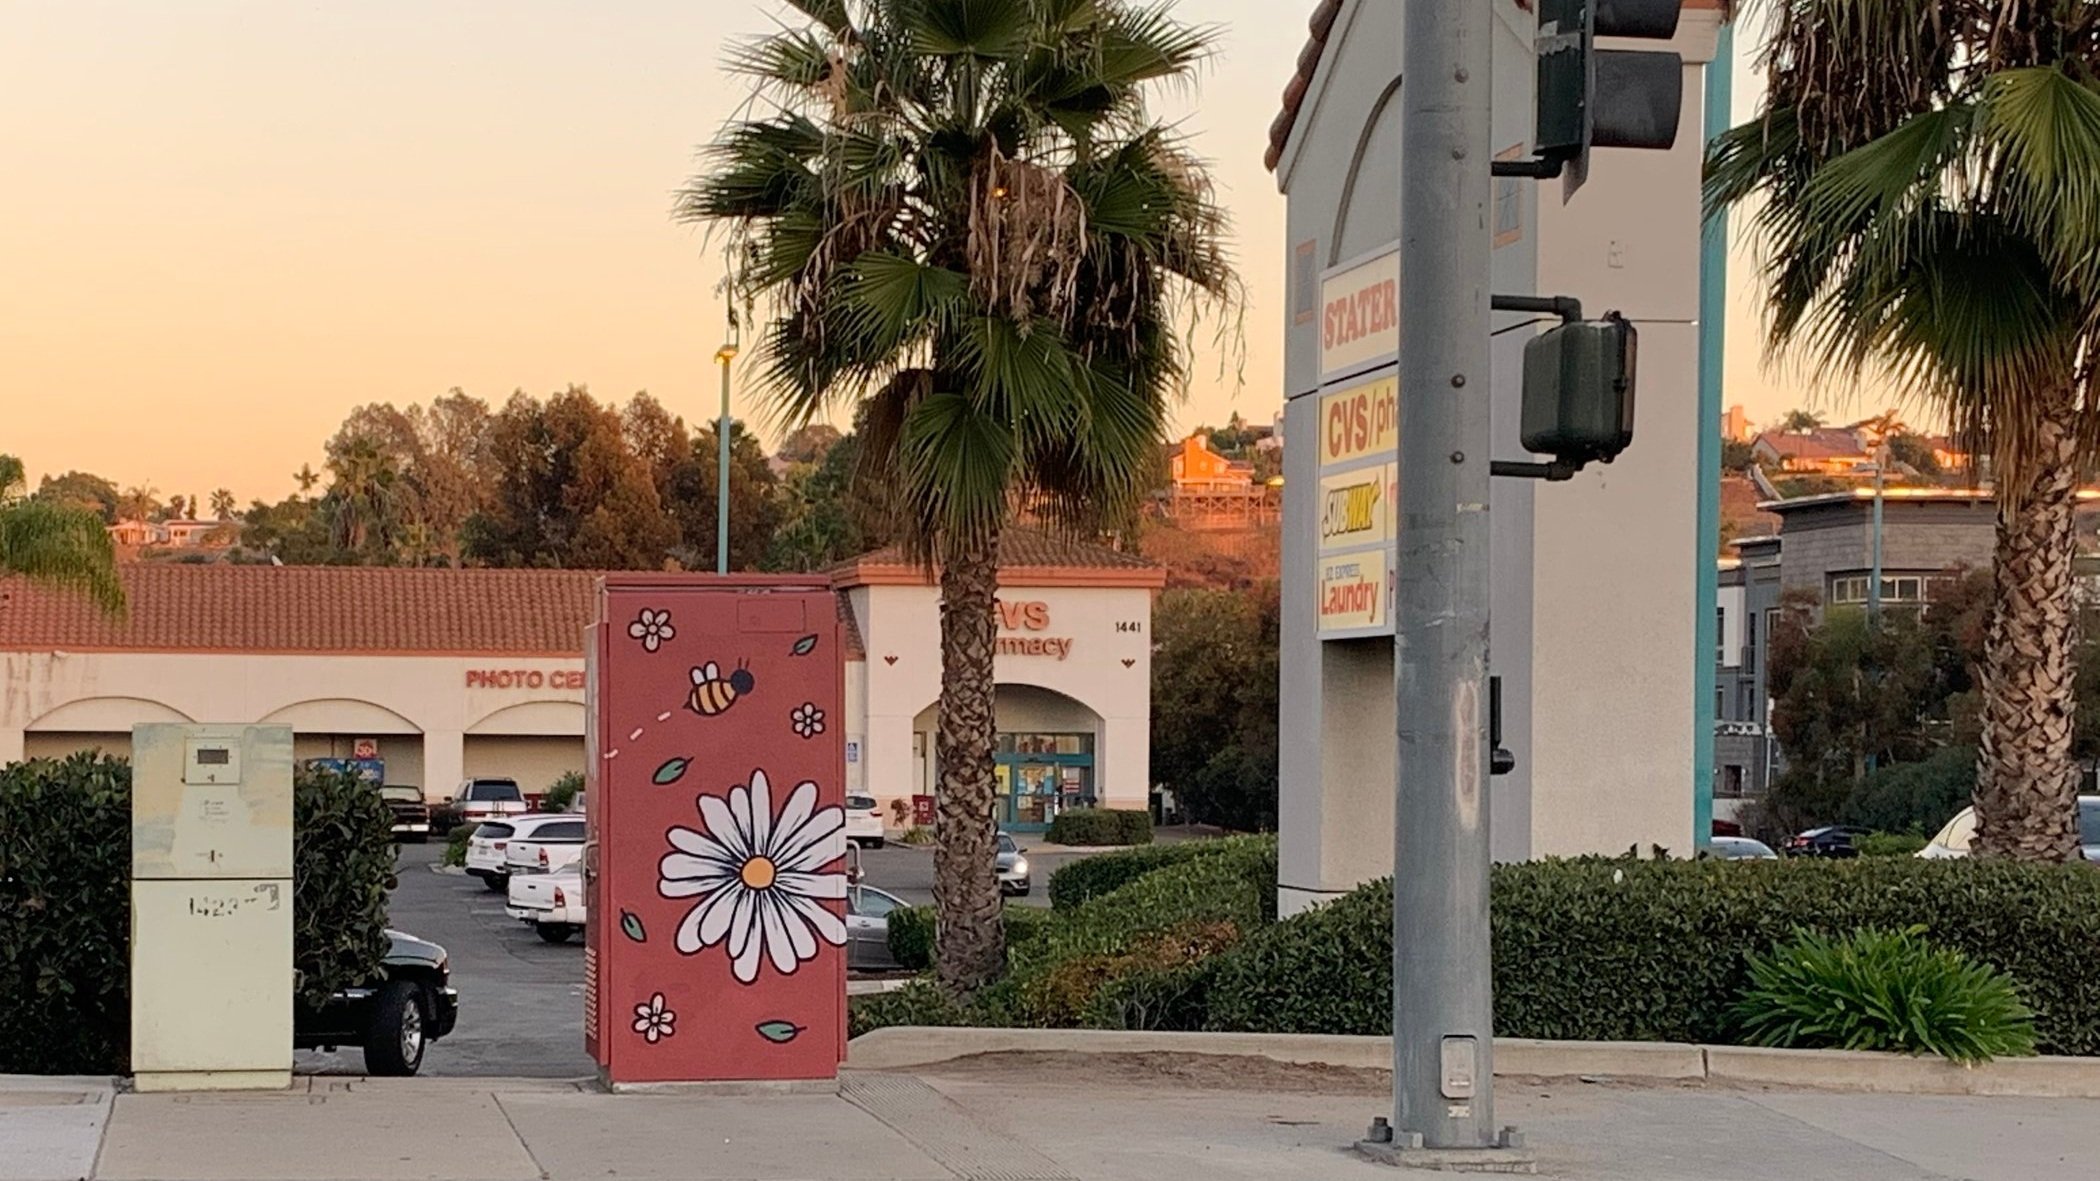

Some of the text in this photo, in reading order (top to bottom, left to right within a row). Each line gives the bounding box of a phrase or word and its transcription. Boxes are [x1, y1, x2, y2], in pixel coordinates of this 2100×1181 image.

[1324, 278, 1397, 351] STATER
[1328, 386, 1398, 458] CVS/ph
[1322, 474, 1381, 538] SUBWAY
[995, 601, 1050, 630] VS
[1321, 574, 1379, 623] Laundry
[1115, 621, 1142, 633] 1441
[466, 670, 543, 688] PHOTO
